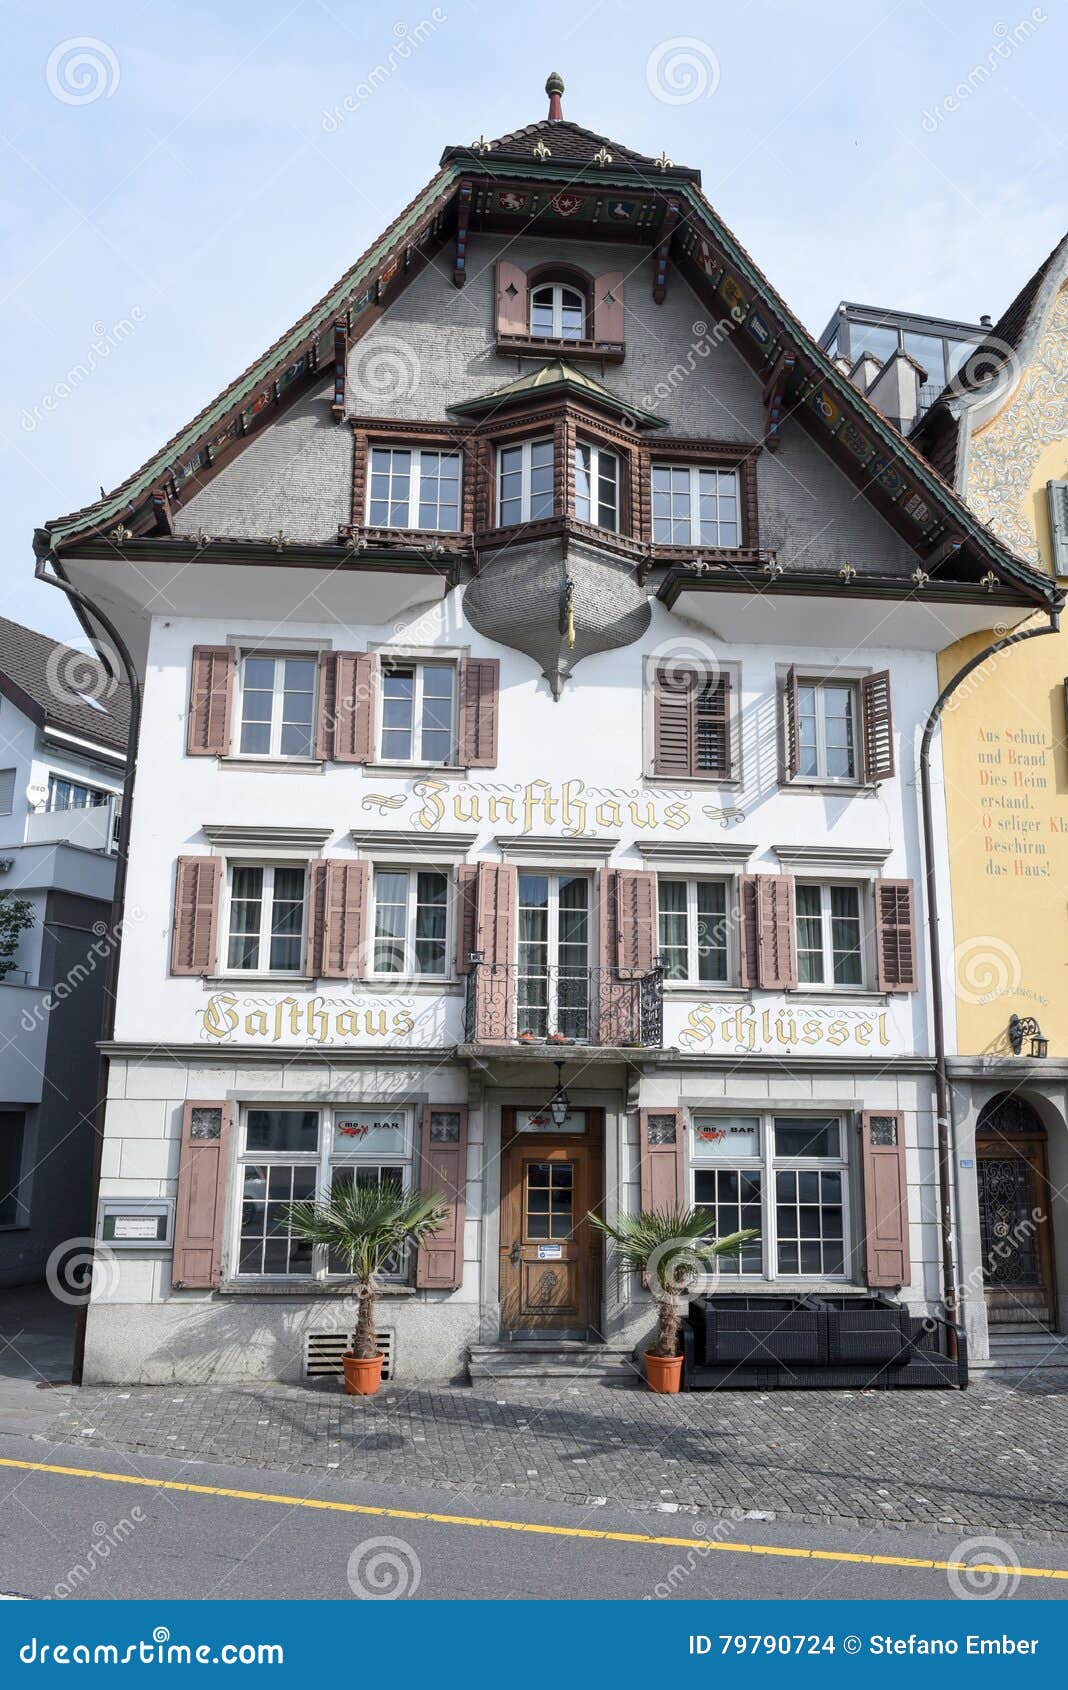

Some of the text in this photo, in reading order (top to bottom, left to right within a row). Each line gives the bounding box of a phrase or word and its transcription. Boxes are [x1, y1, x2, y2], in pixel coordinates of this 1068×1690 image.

[977, 727, 1046, 745] Aus Schutt
[978, 748, 1045, 766] und Brand
[979, 769, 1047, 788] Dies Heim
[413, 775, 692, 837] Zunfthaus
[981, 793, 1034, 809] erstand.
[982, 812, 992, 830] O
[998, 815, 1041, 835] seliger
[985, 836, 1046, 854] Beschirm
[986, 859, 1051, 877] das Haus!
[678, 1002, 890, 1053] Schlüssel
